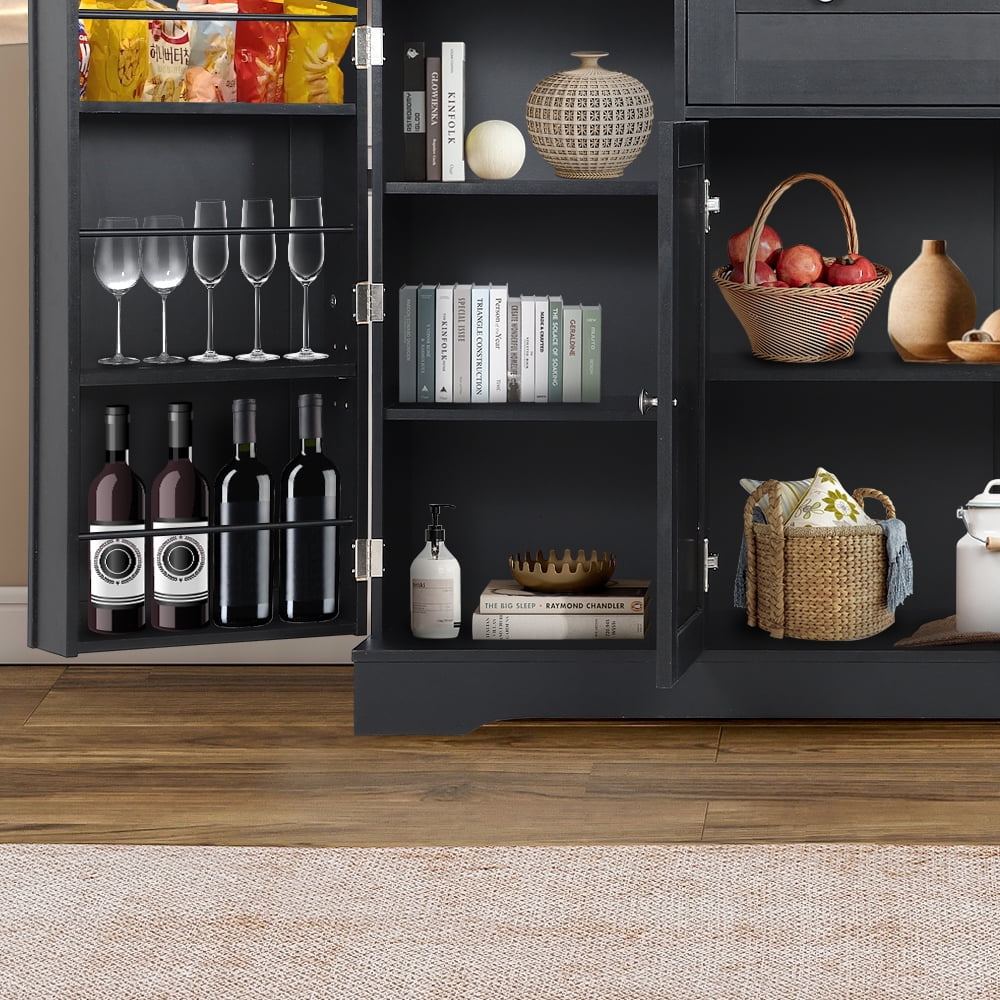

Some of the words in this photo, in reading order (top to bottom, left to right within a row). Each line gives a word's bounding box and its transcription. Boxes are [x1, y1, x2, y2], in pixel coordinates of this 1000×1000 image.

[447, 91, 456, 144] KINFOLK
[457, 298, 466, 322] SPECIAL
[476, 298, 484, 336] TRIANGLE
[457, 325, 466, 342] ISSUE
[476, 336, 484, 395] CONSTRUCTION
[552, 347, 559, 356] OF
